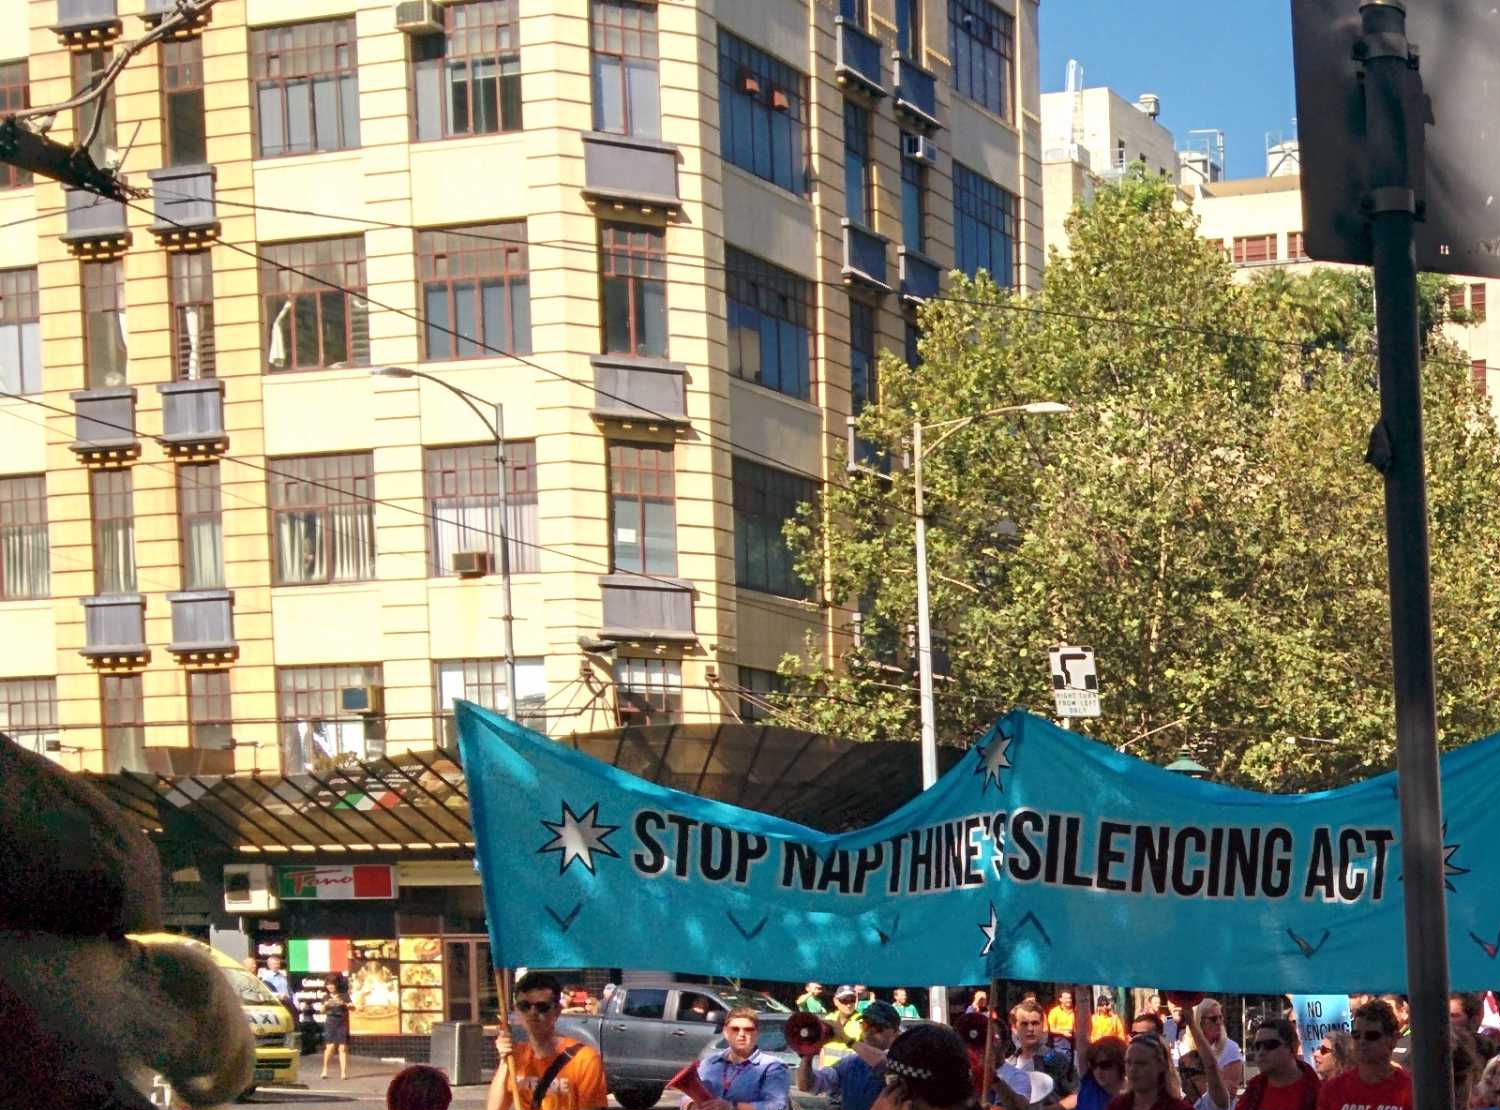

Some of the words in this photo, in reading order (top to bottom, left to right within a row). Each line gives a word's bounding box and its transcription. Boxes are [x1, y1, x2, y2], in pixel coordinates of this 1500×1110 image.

[633, 810, 768, 884] STOP
[1007, 809, 1294, 898] SILENCING
[1304, 828, 1394, 901] ACT
[1307, 1000, 1323, 1018] NO
